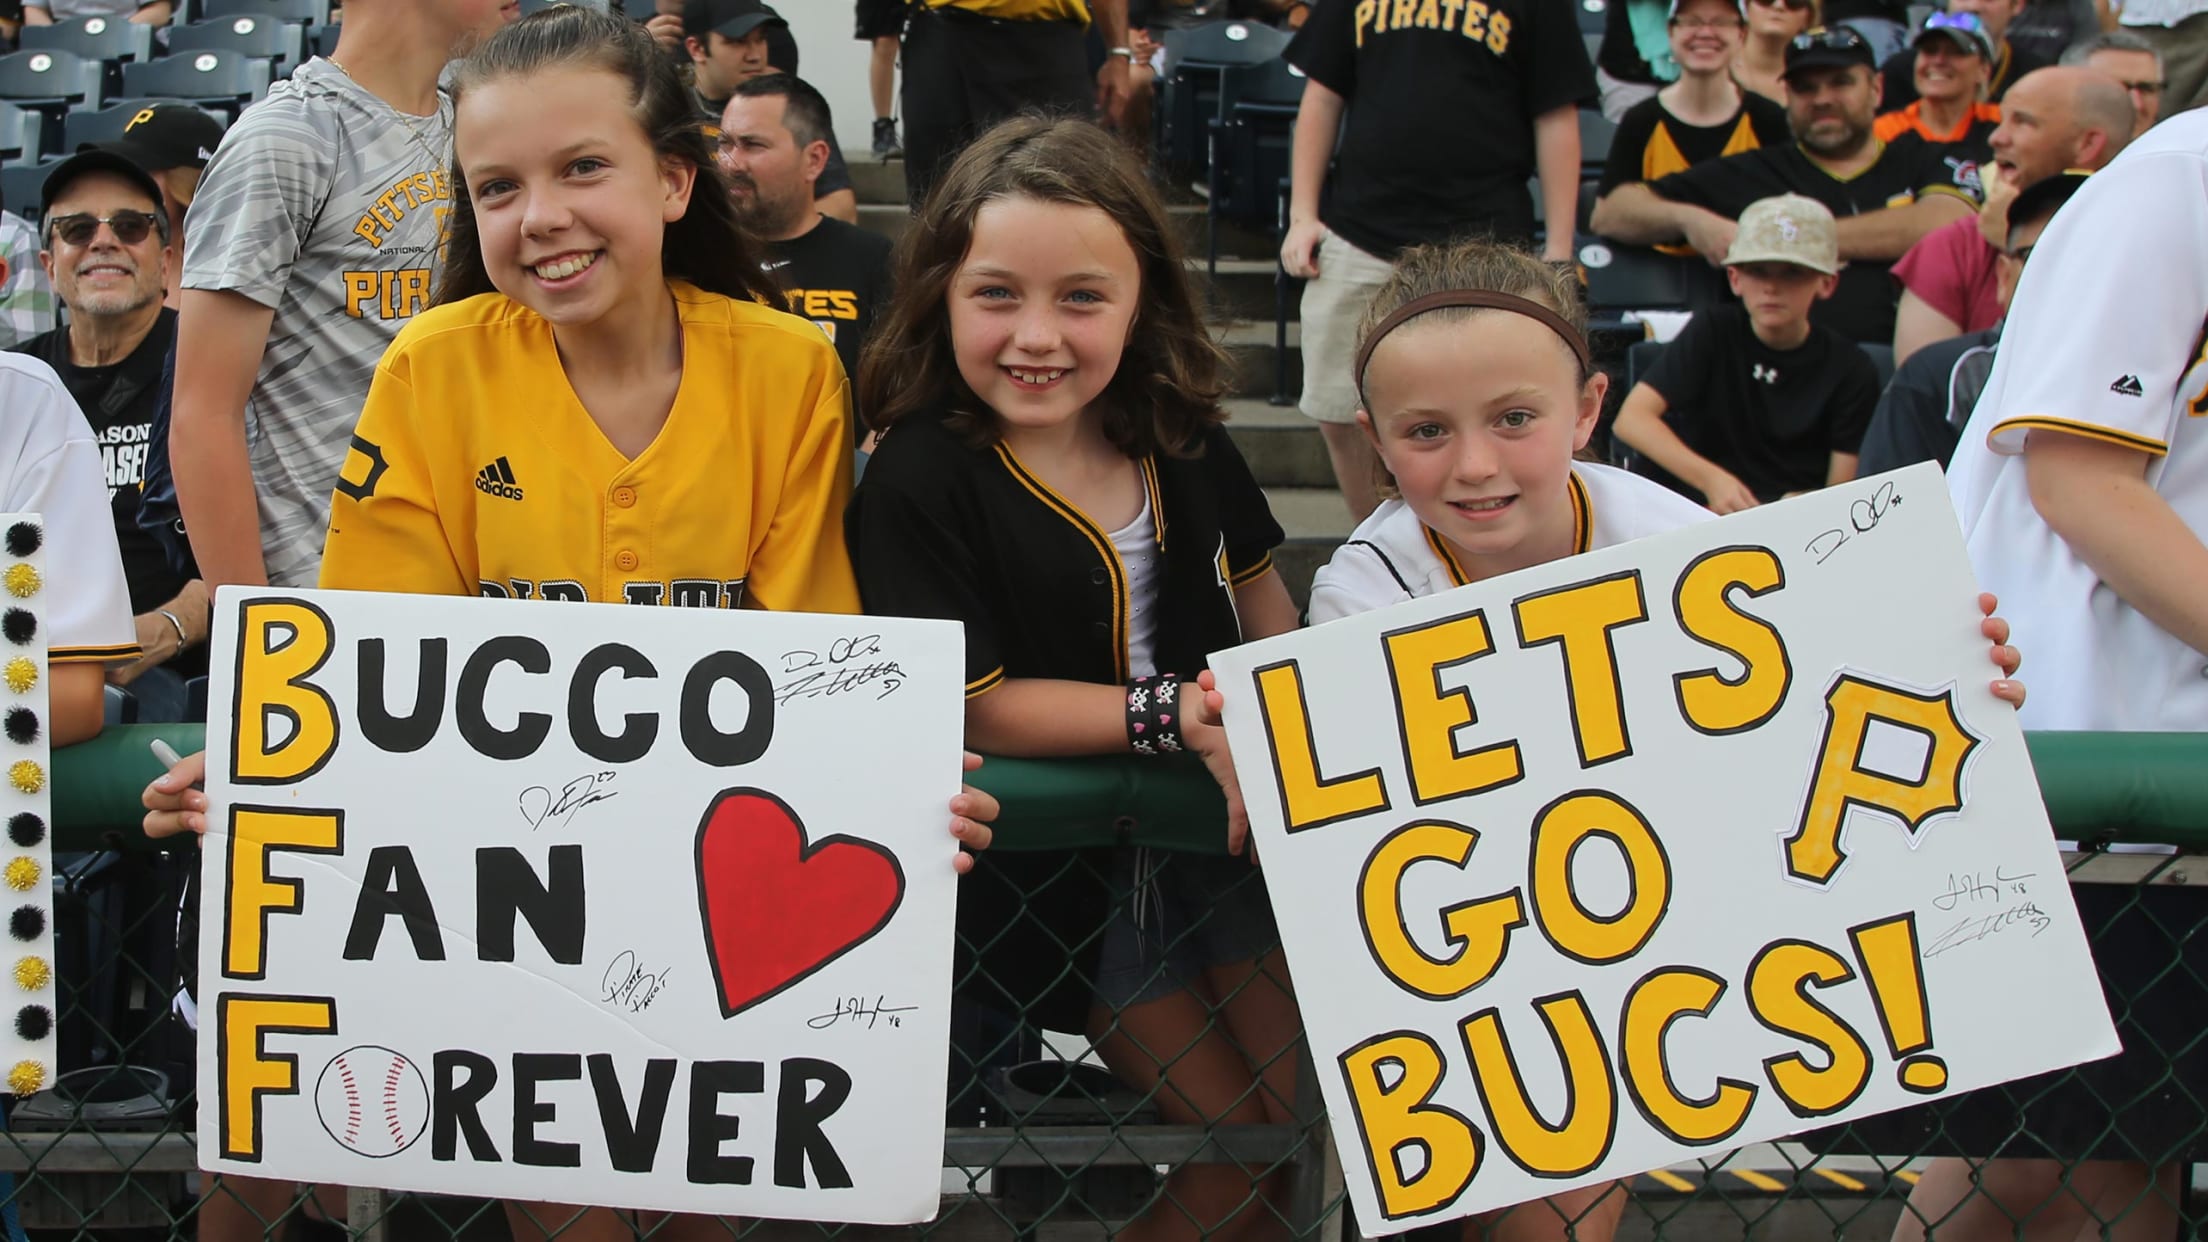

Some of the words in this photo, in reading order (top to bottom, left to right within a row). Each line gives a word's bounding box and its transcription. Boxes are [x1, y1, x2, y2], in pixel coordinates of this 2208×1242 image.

[124, 107, 154, 132] P
[1355, 0, 1512, 56] PIRATES
[379, 245, 427, 256] NATIONAL
[475, 477, 524, 501] adidas
[230, 597, 775, 786] BUCCO
[1252, 543, 1793, 834] LETS
[1783, 673, 1982, 885] P
[221, 803, 586, 981] FAN
[1357, 788, 1672, 1001] GO
[1337, 911, 1948, 1220] BUCS!
